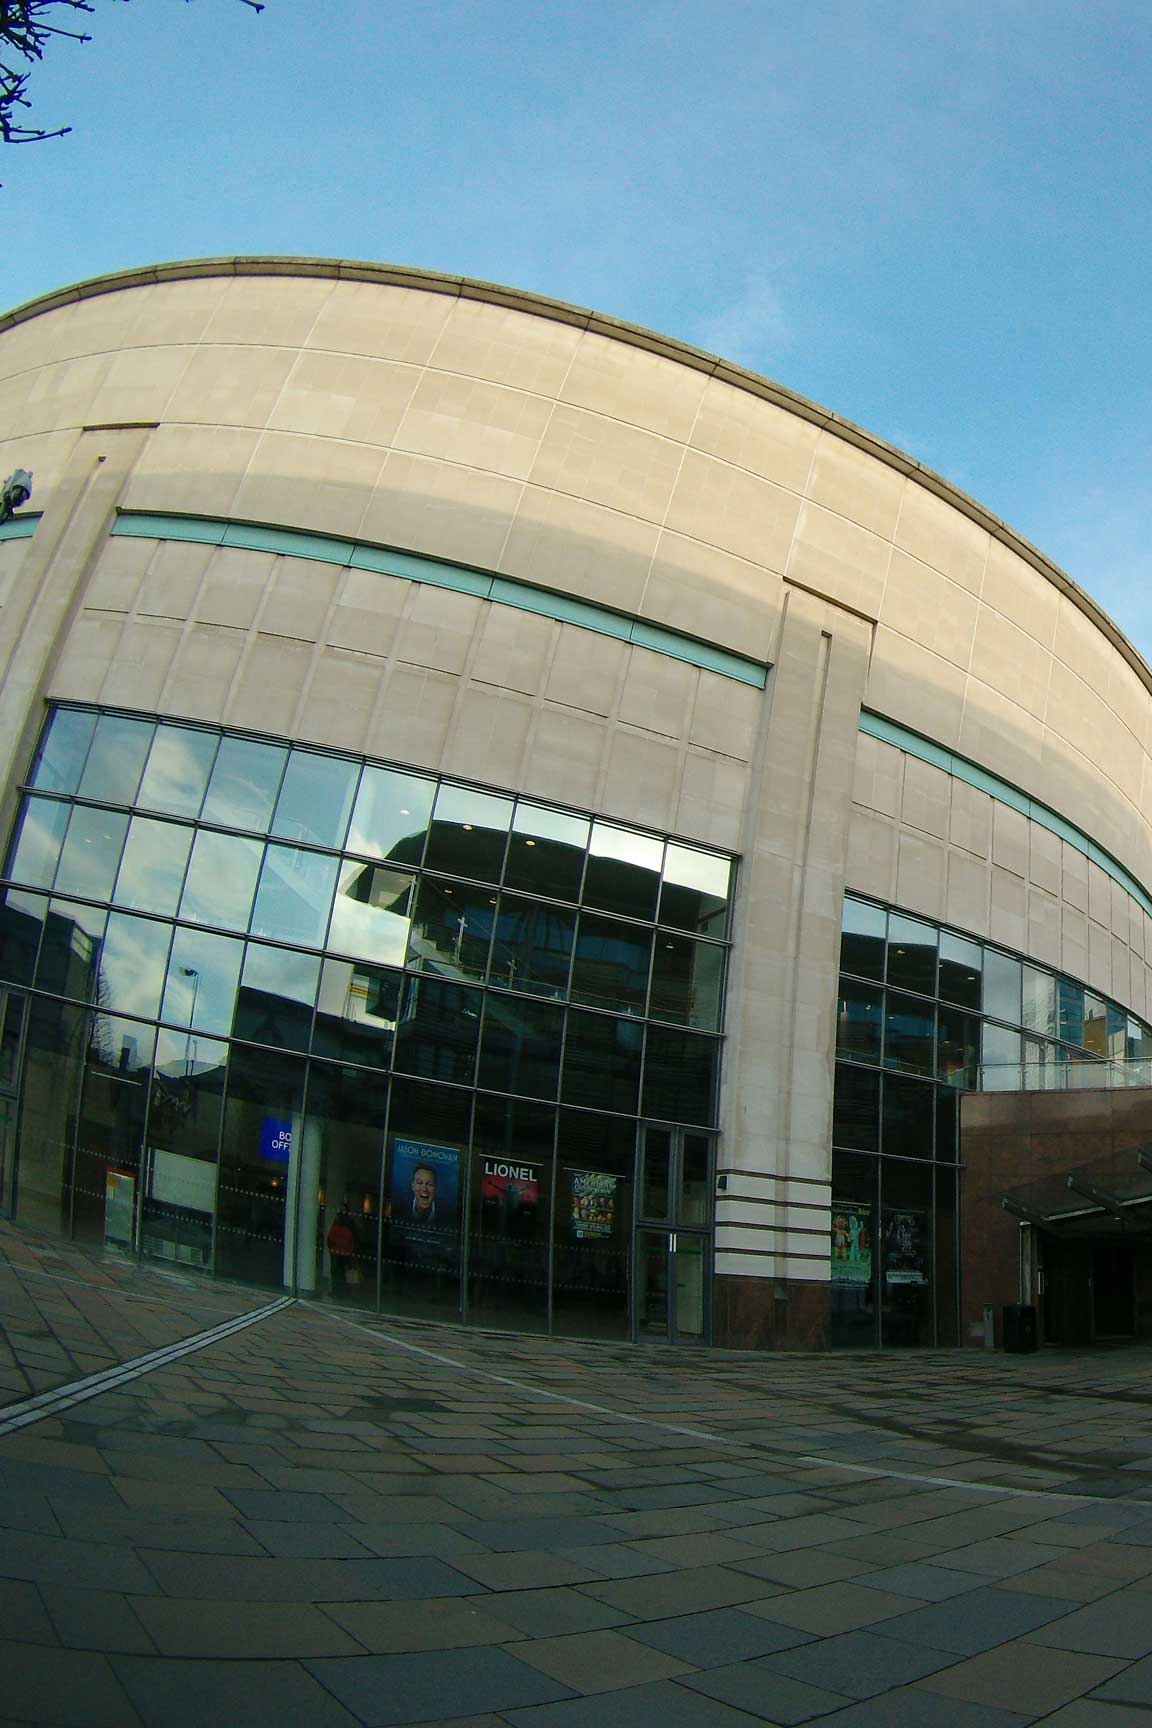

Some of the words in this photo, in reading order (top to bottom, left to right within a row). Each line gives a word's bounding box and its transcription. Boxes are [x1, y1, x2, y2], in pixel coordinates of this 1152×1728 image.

[279, 1131, 292, 1141] BO
[271, 1140, 291, 1151] OFF
[485, 1161, 538, 1181] LIONEL
